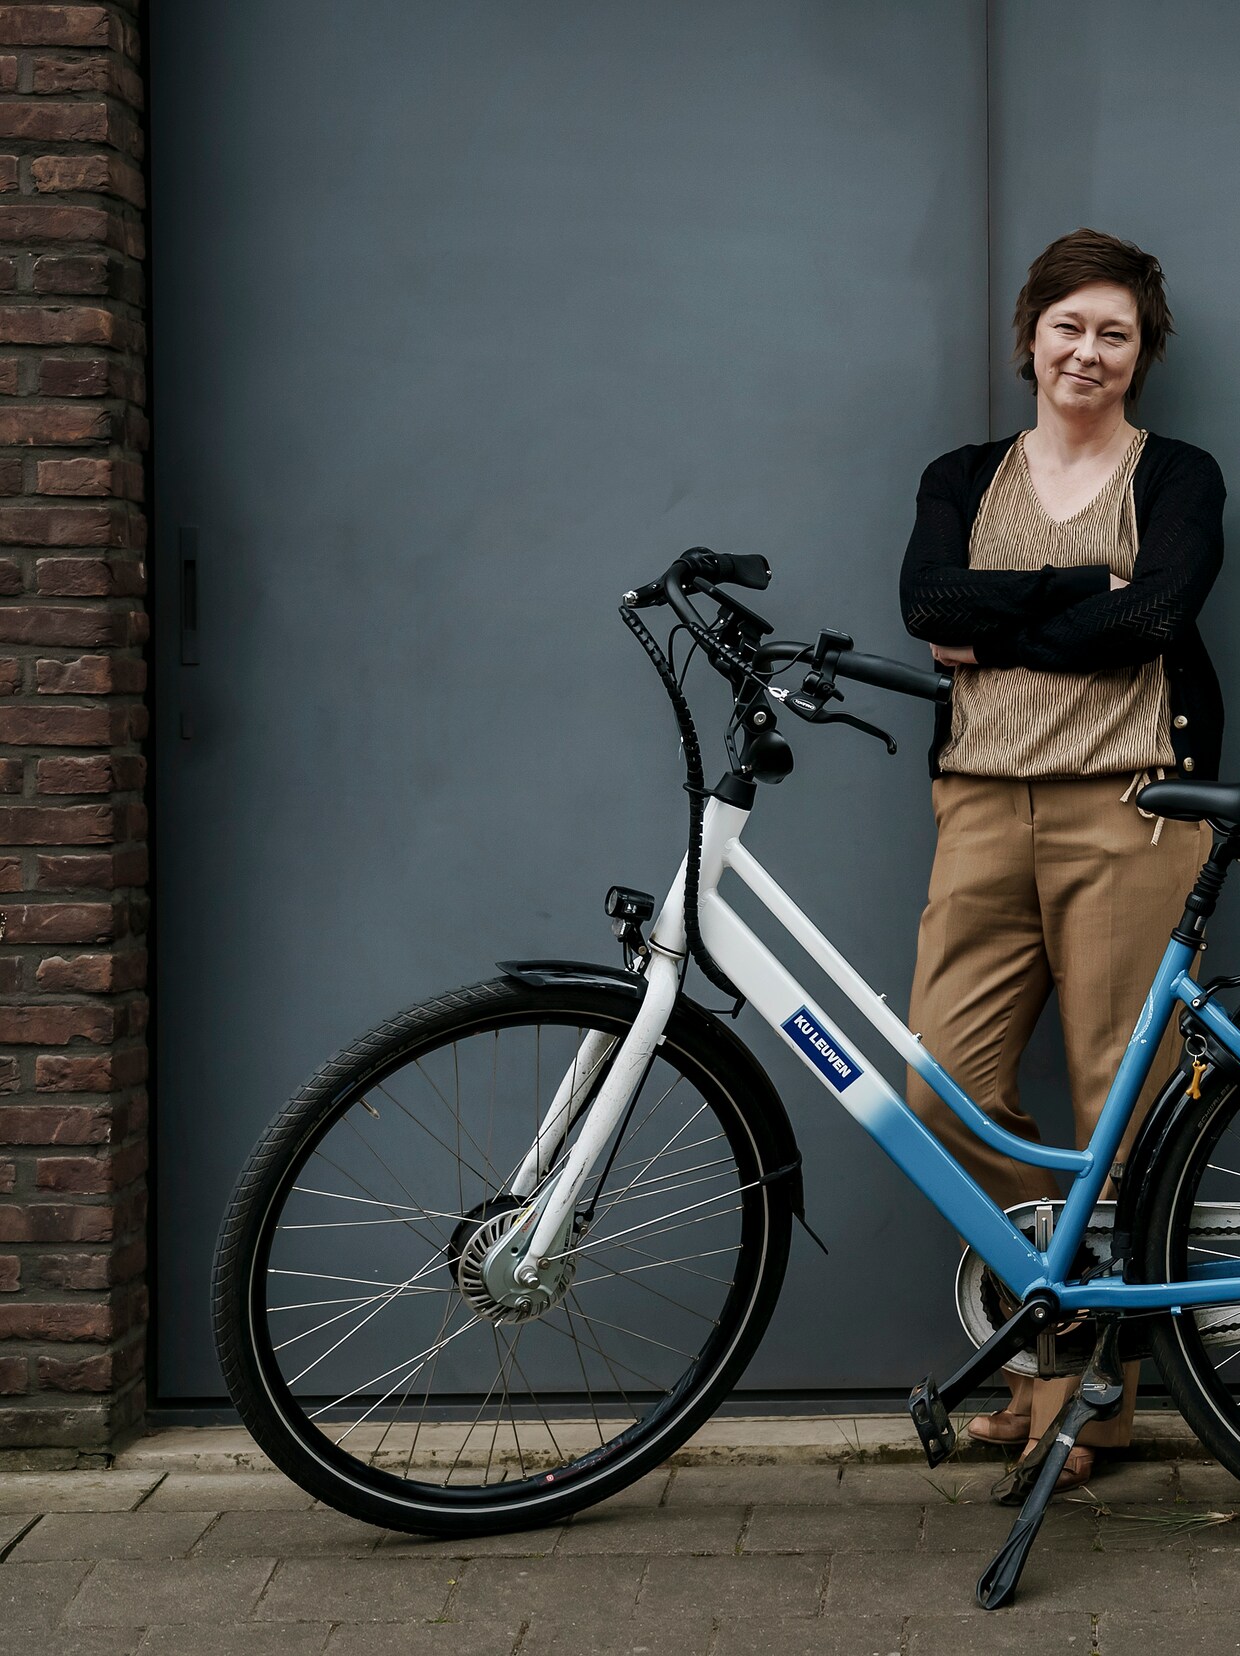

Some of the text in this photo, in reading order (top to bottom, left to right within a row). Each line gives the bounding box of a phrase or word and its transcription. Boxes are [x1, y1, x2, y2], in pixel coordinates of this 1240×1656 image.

[793, 1014, 852, 1079] KU LEUVEN
[1197, 1084, 1231, 1129] SCHWALBE
